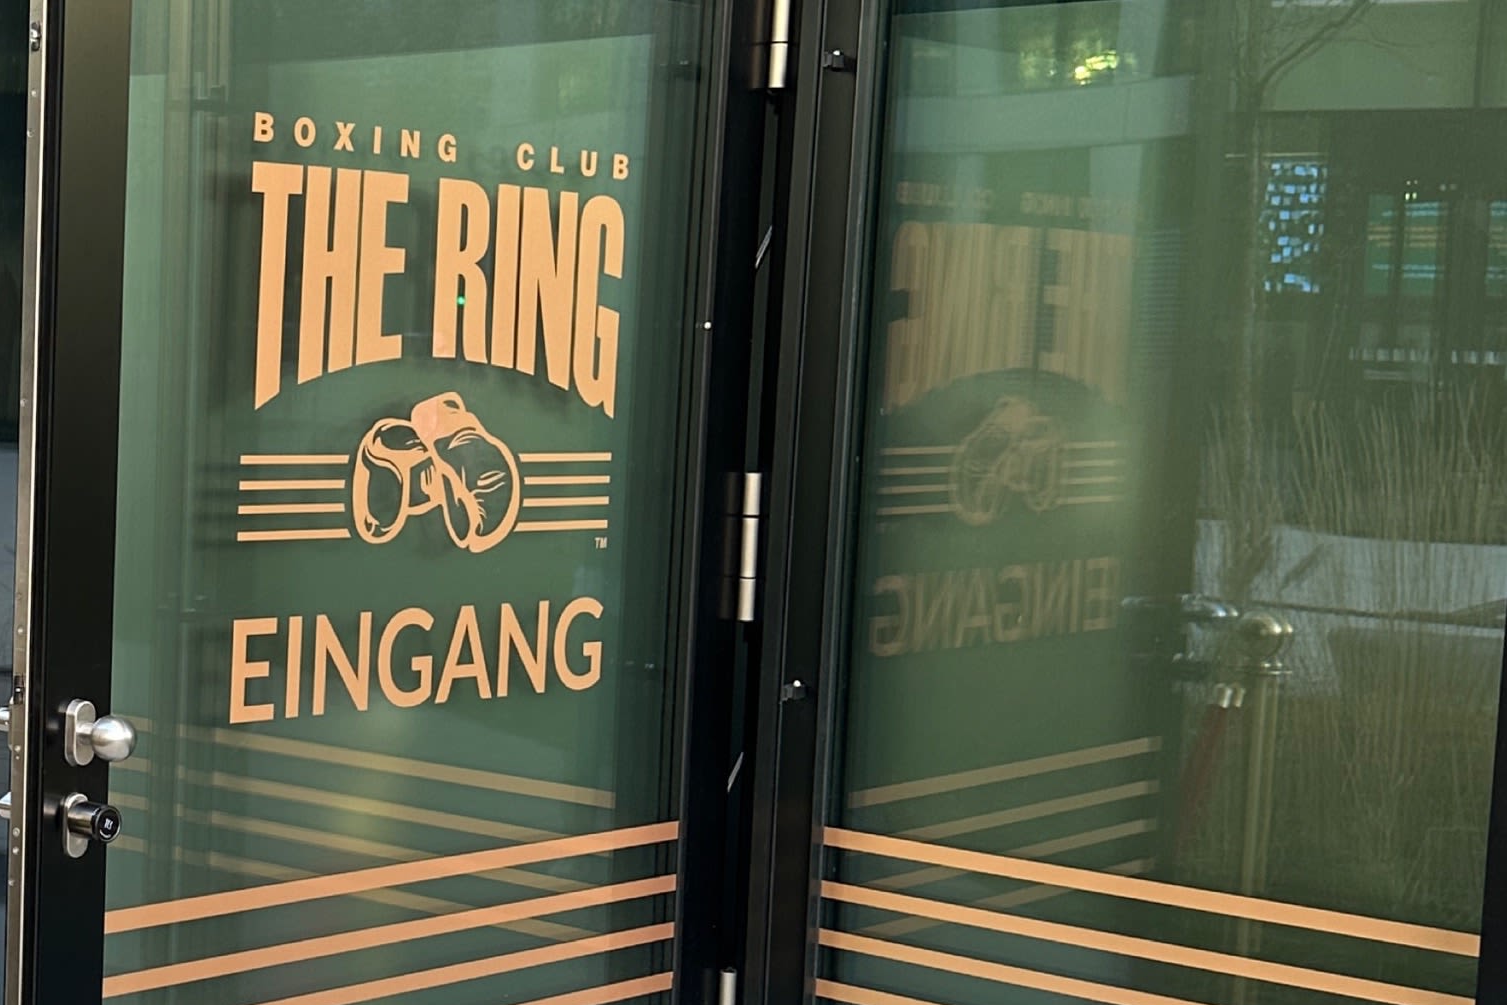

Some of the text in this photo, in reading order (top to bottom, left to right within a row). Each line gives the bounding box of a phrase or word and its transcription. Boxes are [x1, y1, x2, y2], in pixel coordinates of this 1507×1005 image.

[253, 112, 630, 180] BOXING CLUB
[252, 161, 625, 420] THE RING
[228, 596, 604, 725] EINGANG
